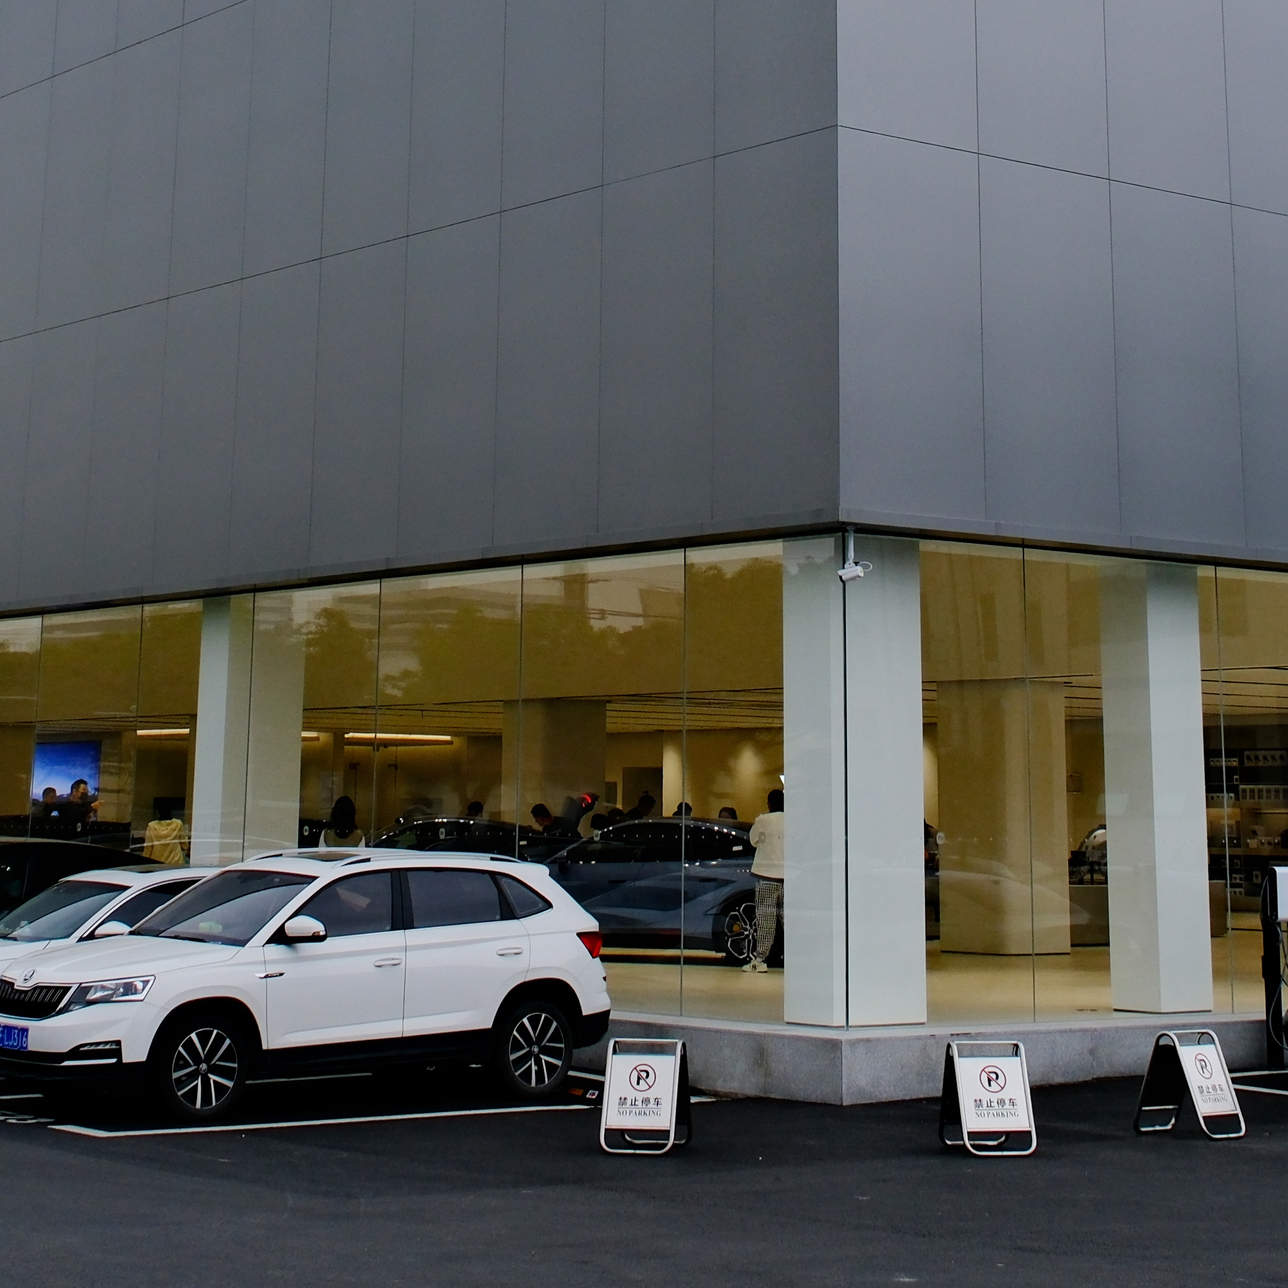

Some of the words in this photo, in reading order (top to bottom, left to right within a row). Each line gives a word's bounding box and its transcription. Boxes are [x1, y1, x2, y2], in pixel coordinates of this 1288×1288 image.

[617, 1096, 662, 1107] 禁止停车
[974, 1097, 1018, 1109] 禁止停车
[617, 1109, 628, 1117] NO
[628, 1109, 662, 1117] PARKING
[987, 1110, 1019, 1118] PARKING
